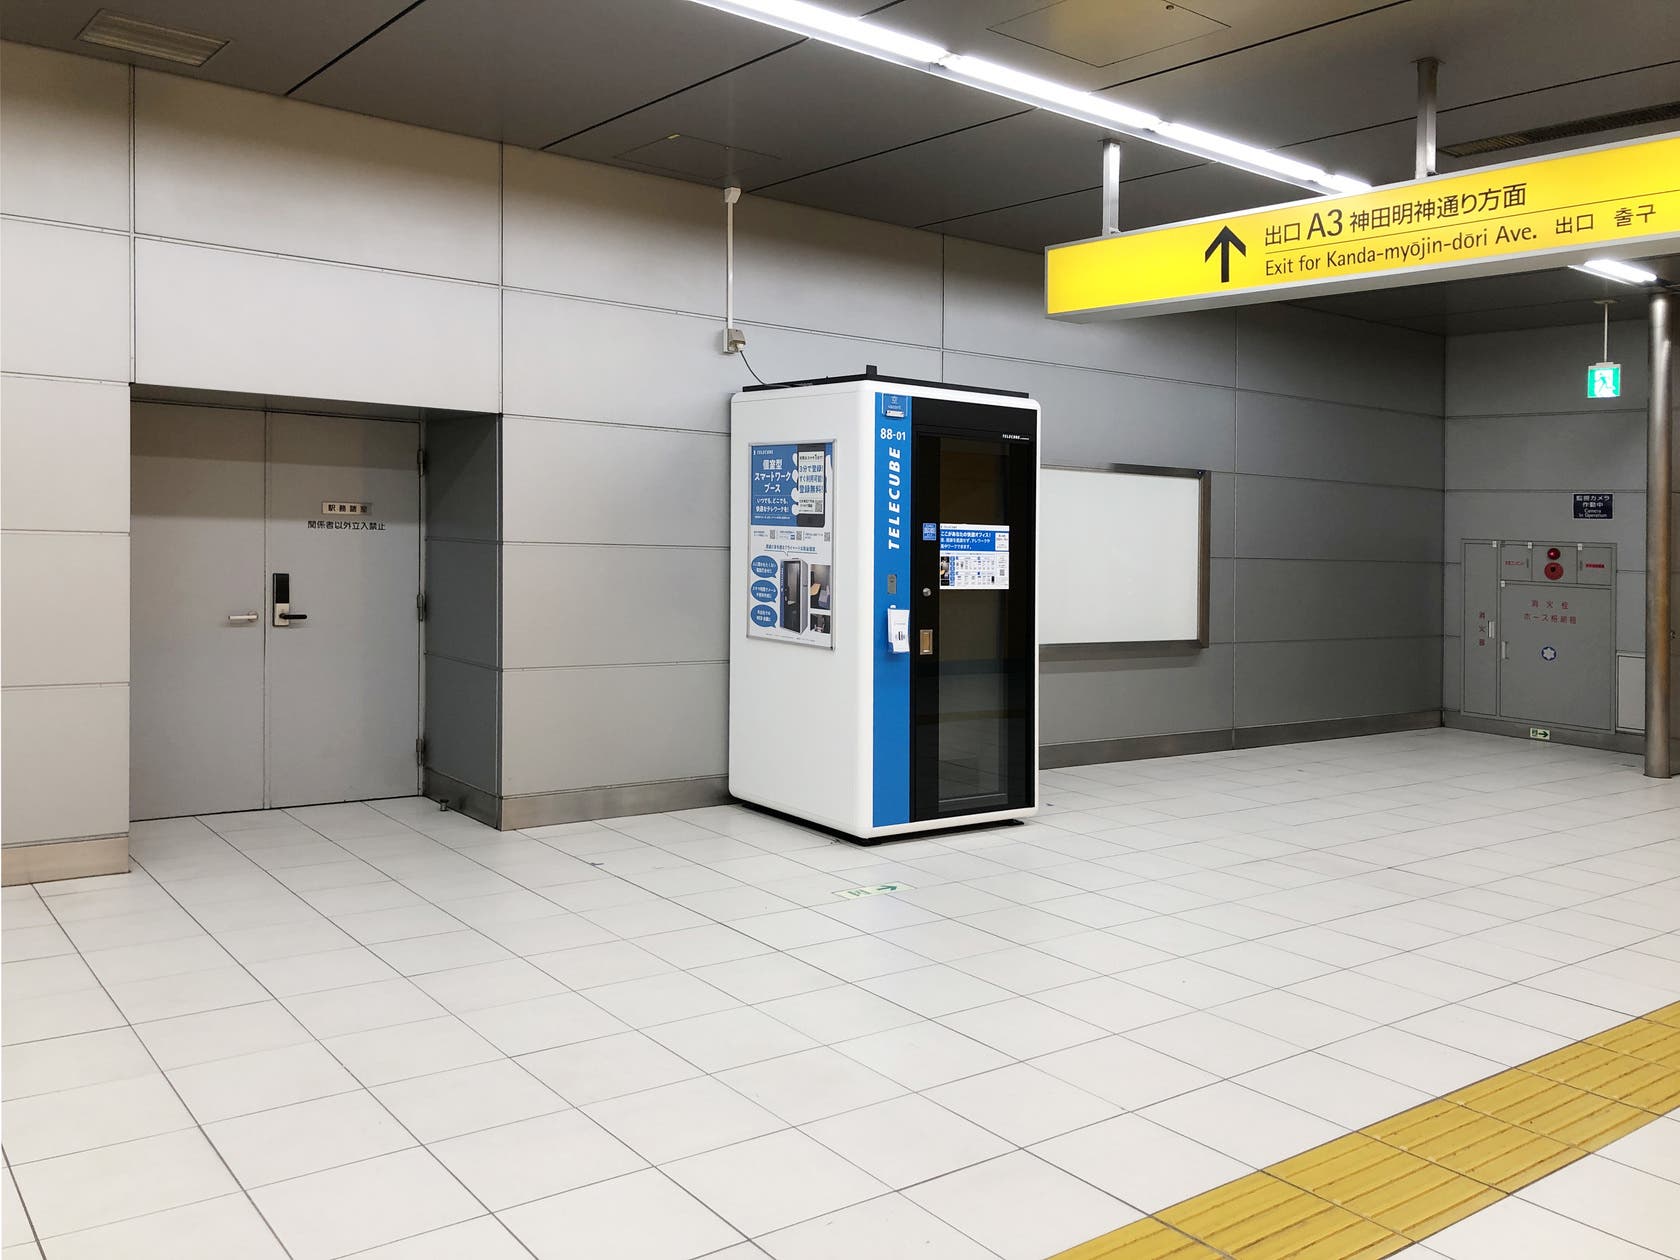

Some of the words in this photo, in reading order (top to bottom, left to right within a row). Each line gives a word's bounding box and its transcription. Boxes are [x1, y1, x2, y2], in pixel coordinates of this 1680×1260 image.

[1265, 225, 1300, 246] 出口
[1307, 209, 1343, 240] A3
[1349, 183, 1527, 233] 神田明神通り方面
[1614, 204, 1656, 227] 출구
[1556, 216, 1594, 234] 出口
[1266, 257, 1294, 276] Exit
[1299, 255, 1321, 271] for
[1327, 228, 1488, 268] Kanda-myōjin-dōri
[1495, 225, 1537, 245] Ave.
[880, 428, 906, 441] 88-01
[754, 472, 791, 482] スマートワーク
[764, 482, 781, 493] ブース
[888, 447, 901, 550] TELECUBE
[307, 520, 387, 530] 関係者以外立入禁止
